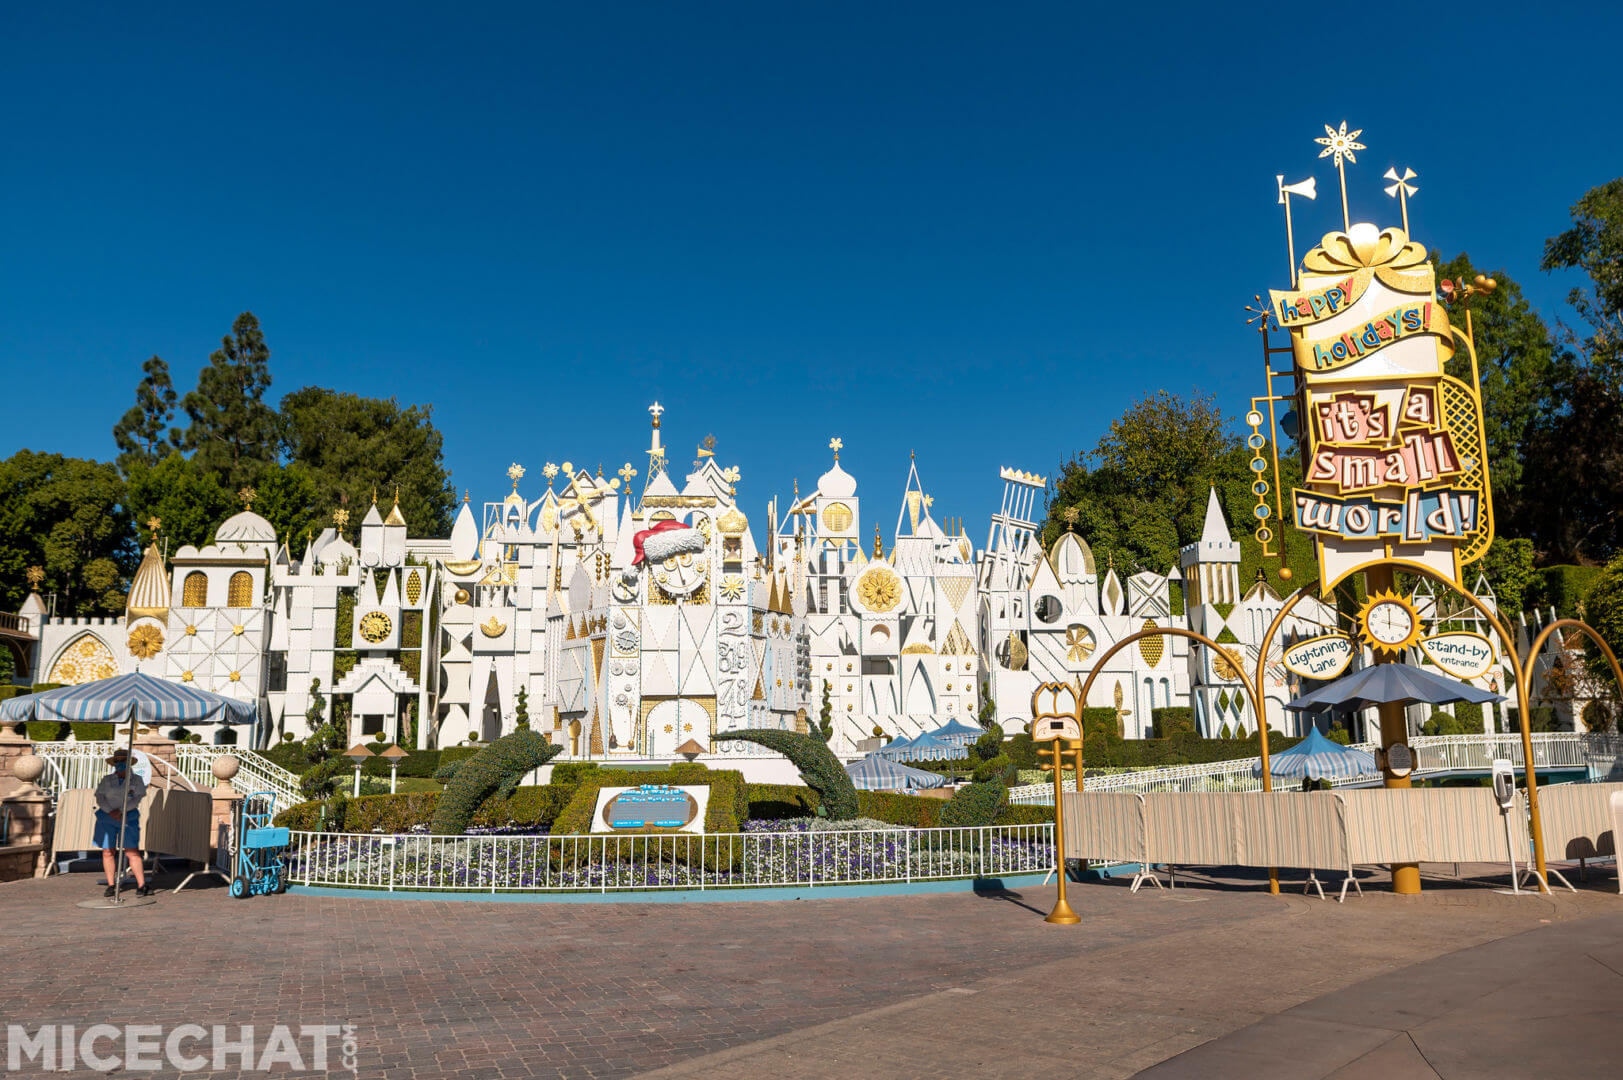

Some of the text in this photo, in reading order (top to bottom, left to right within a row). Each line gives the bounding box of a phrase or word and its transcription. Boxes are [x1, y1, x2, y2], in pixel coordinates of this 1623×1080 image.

[1281, 278, 1354, 321] happy
[1314, 302, 1432, 367] holidays!
[1320, 393, 1431, 440] it's a
[1313, 430, 1454, 487] small
[1297, 493, 1472, 539] world!
[1289, 640, 1348, 665] Lightning
[1310, 658, 1336, 673] Lane
[1428, 641, 1489, 660] stand-by
[1441, 657, 1479, 668] entrance
